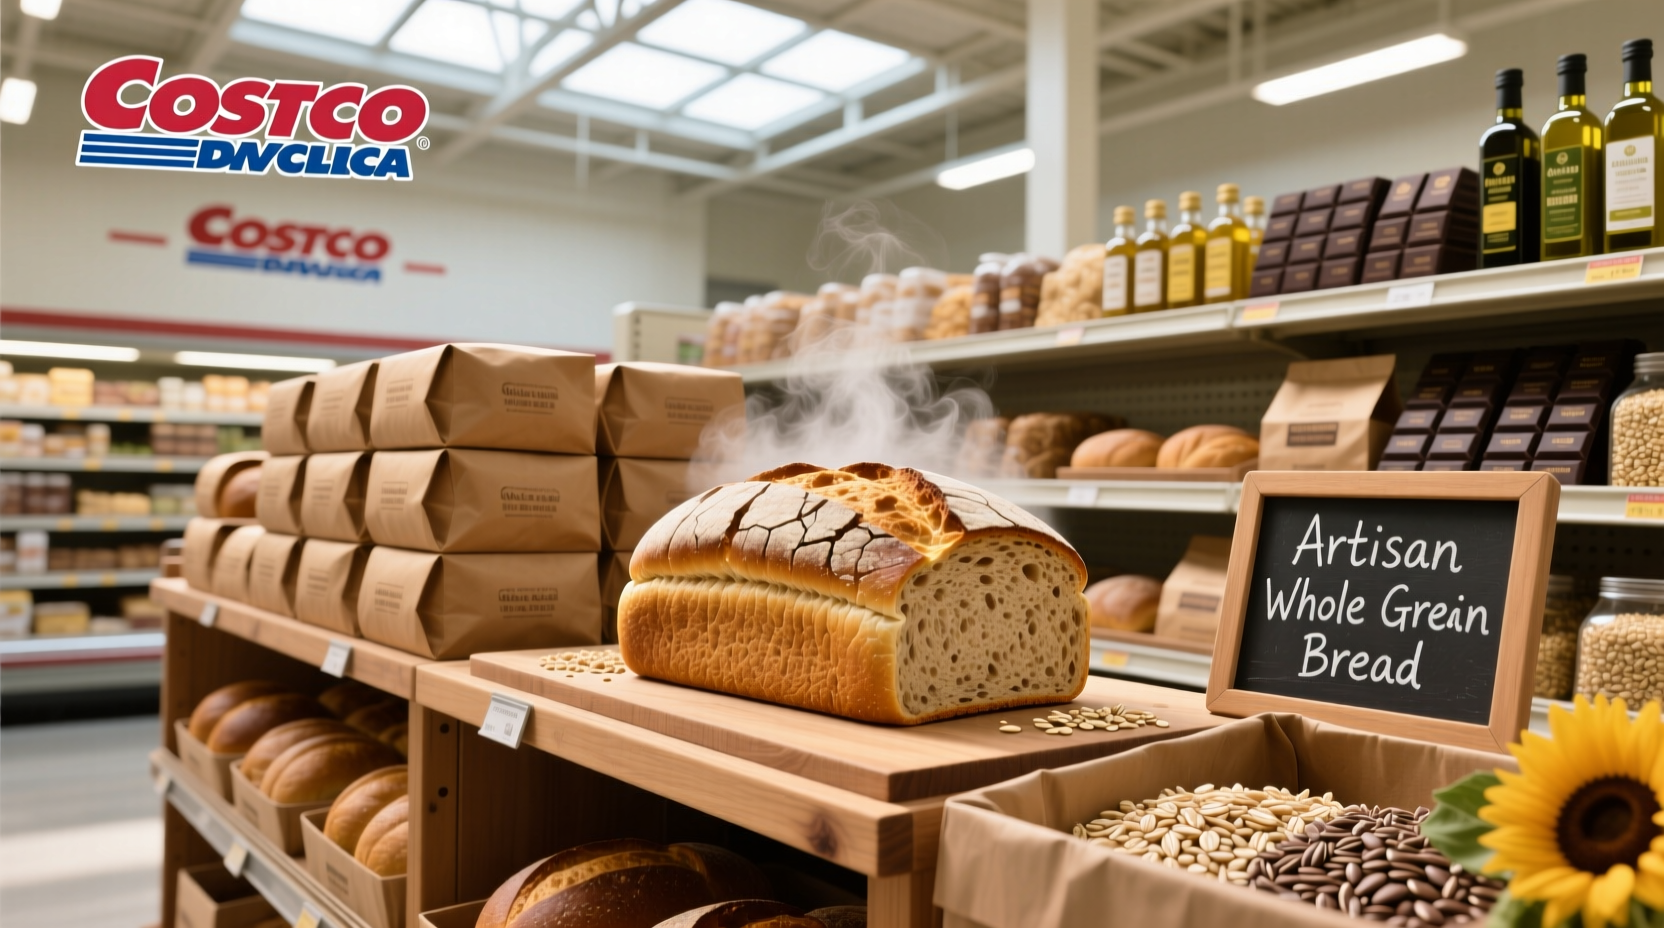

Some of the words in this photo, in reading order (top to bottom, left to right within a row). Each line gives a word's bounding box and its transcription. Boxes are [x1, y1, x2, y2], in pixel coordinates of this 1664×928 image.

[188, 205, 391, 262] COSTCO
[1291, 512, 1463, 573] Artisan
[1266, 576, 1366, 626] Whole
[1297, 632, 1424, 690] Bread
